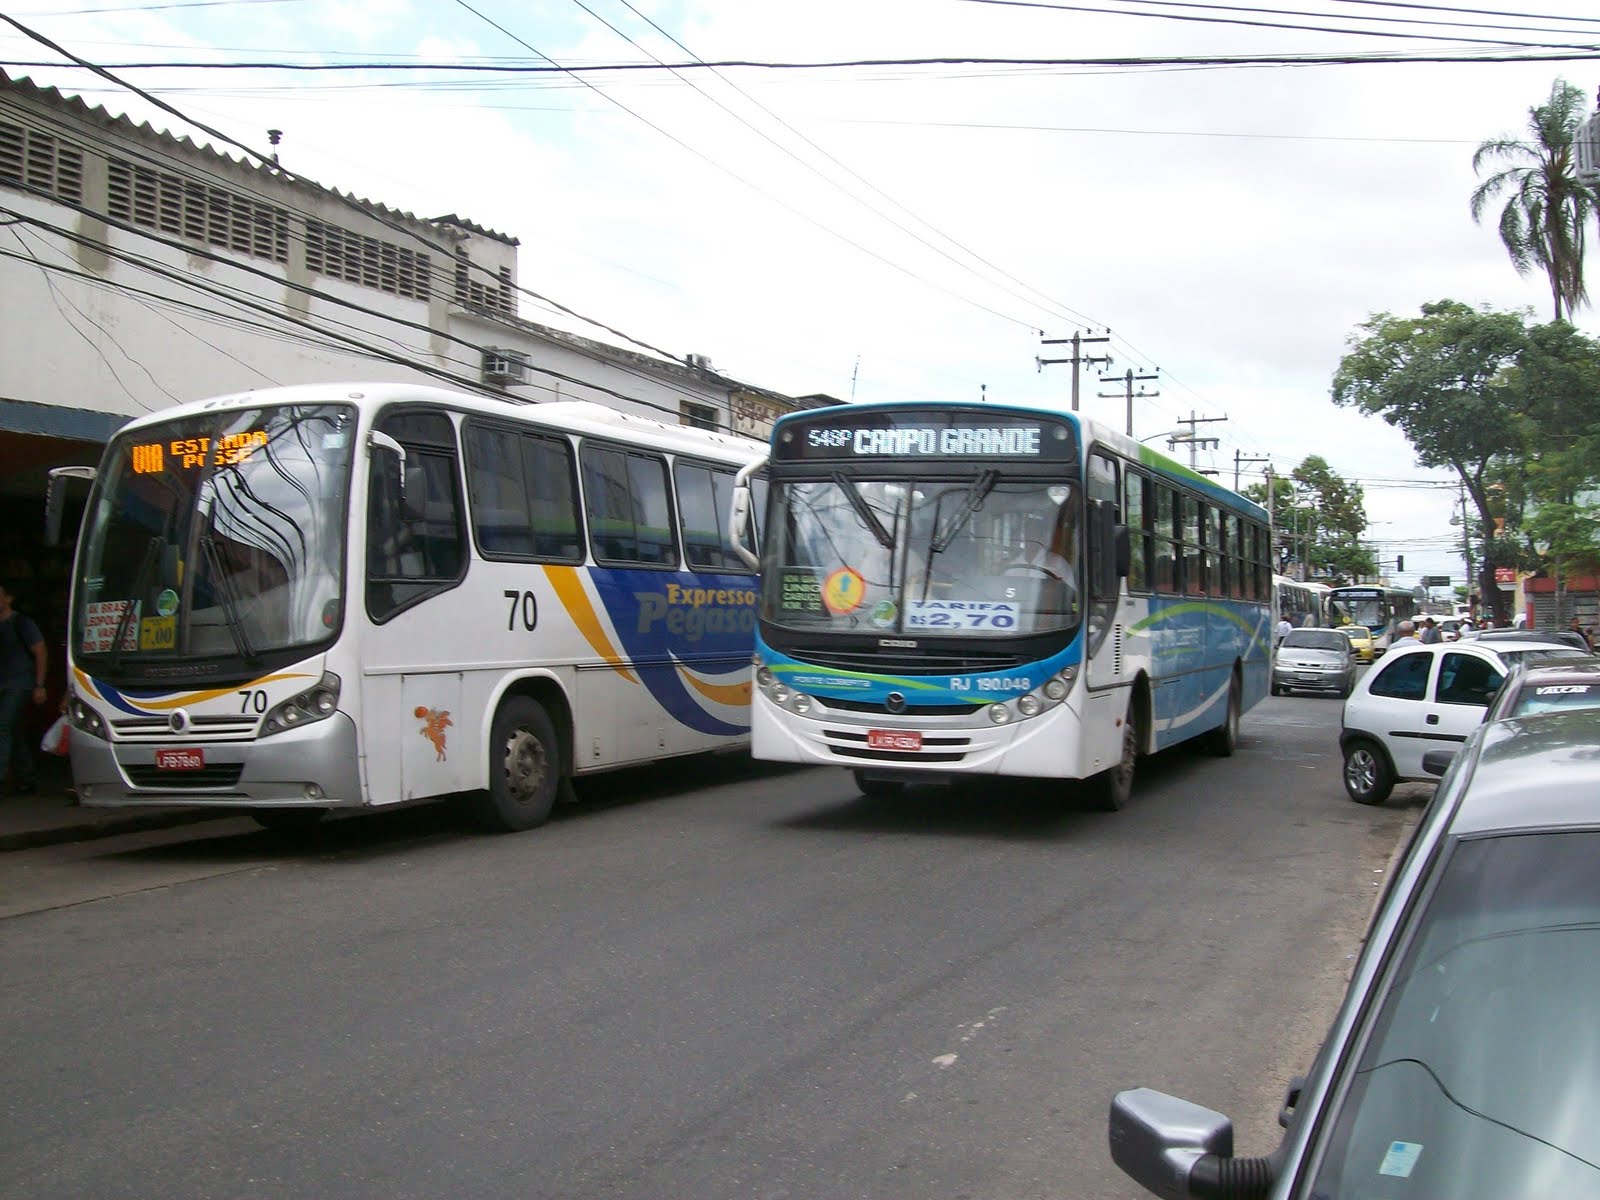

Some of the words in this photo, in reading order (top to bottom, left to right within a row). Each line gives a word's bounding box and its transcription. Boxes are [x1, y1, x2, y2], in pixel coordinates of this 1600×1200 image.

[853, 428, 936, 454] CAMPO
[940, 428, 1041, 454] GRANDE
[665, 583, 756, 608] Expresso
[1004, 587, 1017, 598] 5
[504, 590, 538, 632] 70
[634, 592, 756, 641] Pegaso
[911, 601, 1014, 612] TARIFA
[929, 612, 1014, 629] 2,70
[950, 677, 971, 691] RJ
[238, 690, 268, 714] 70
